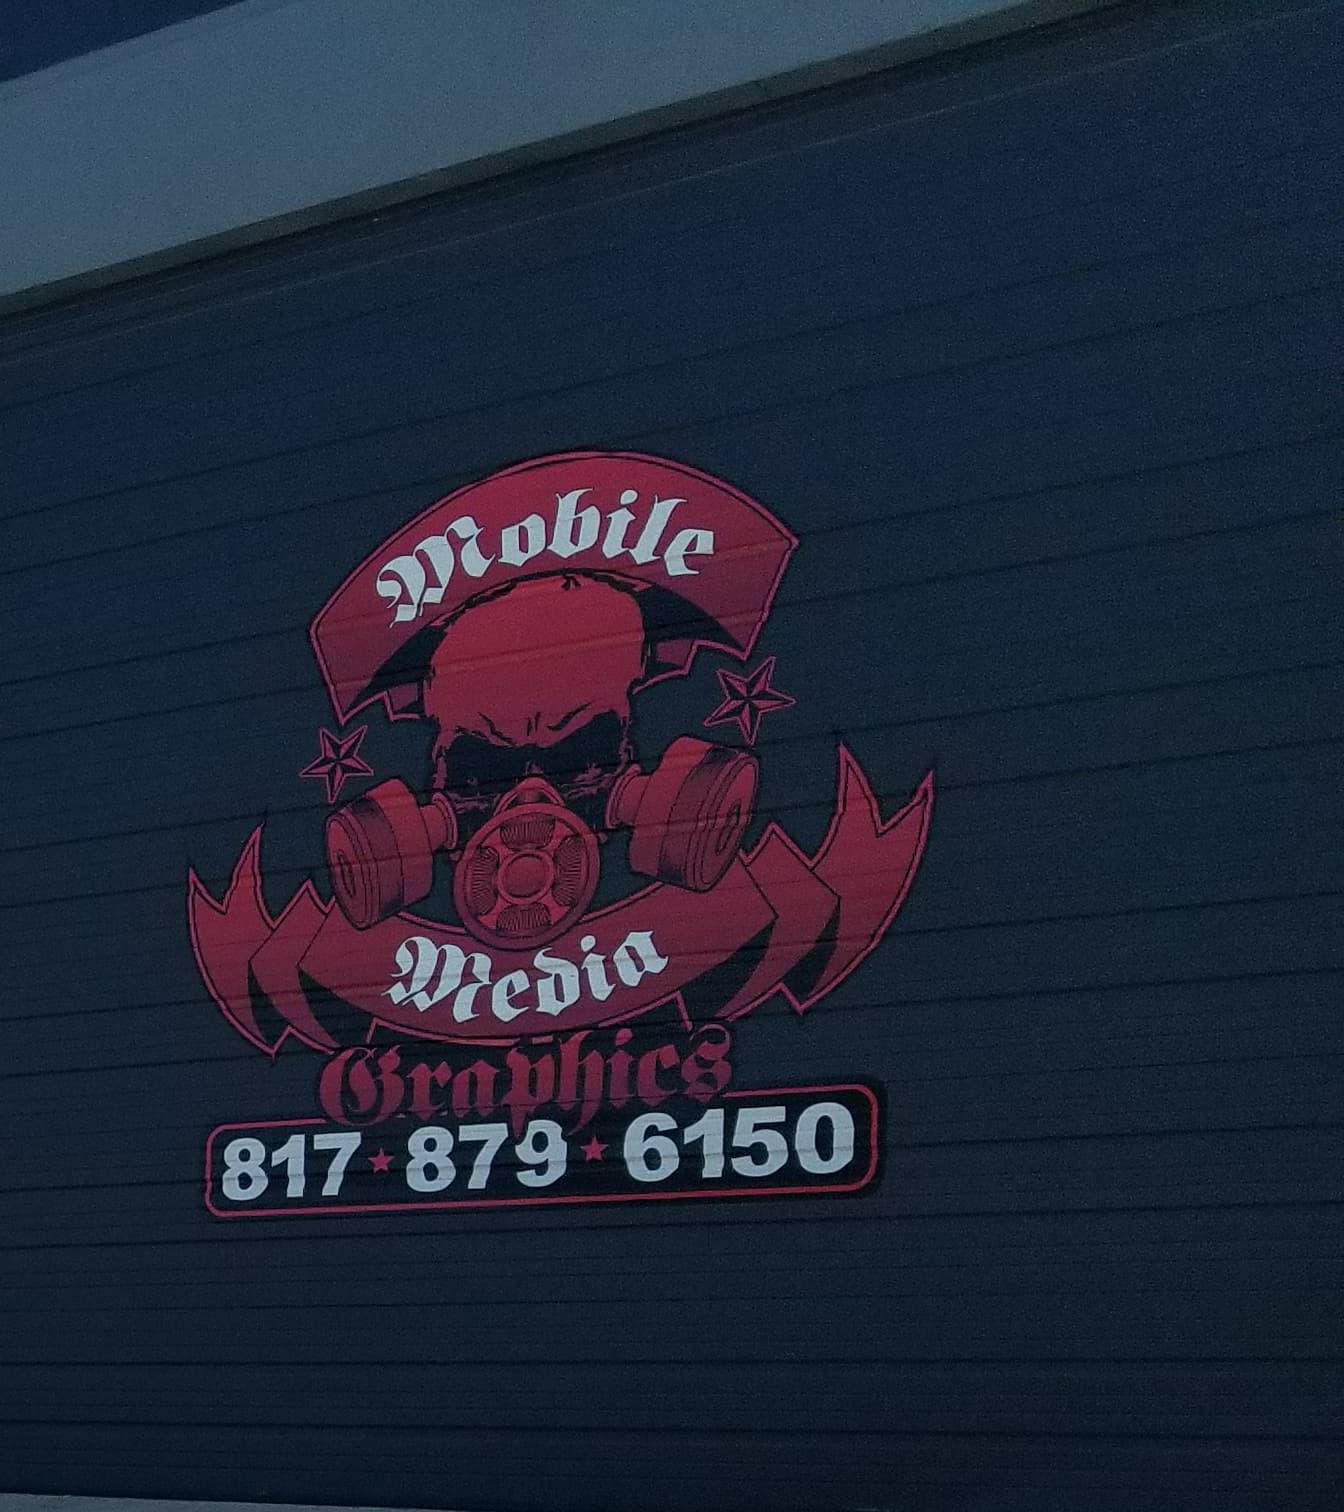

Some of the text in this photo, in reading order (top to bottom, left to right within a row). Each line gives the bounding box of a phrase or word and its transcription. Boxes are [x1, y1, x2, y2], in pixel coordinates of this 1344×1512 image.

[375, 487, 715, 629] Mobile
[380, 926, 669, 1025] Media
[319, 1023, 733, 1138] Graphics
[220, 1101, 856, 1202] 817 879 6150
